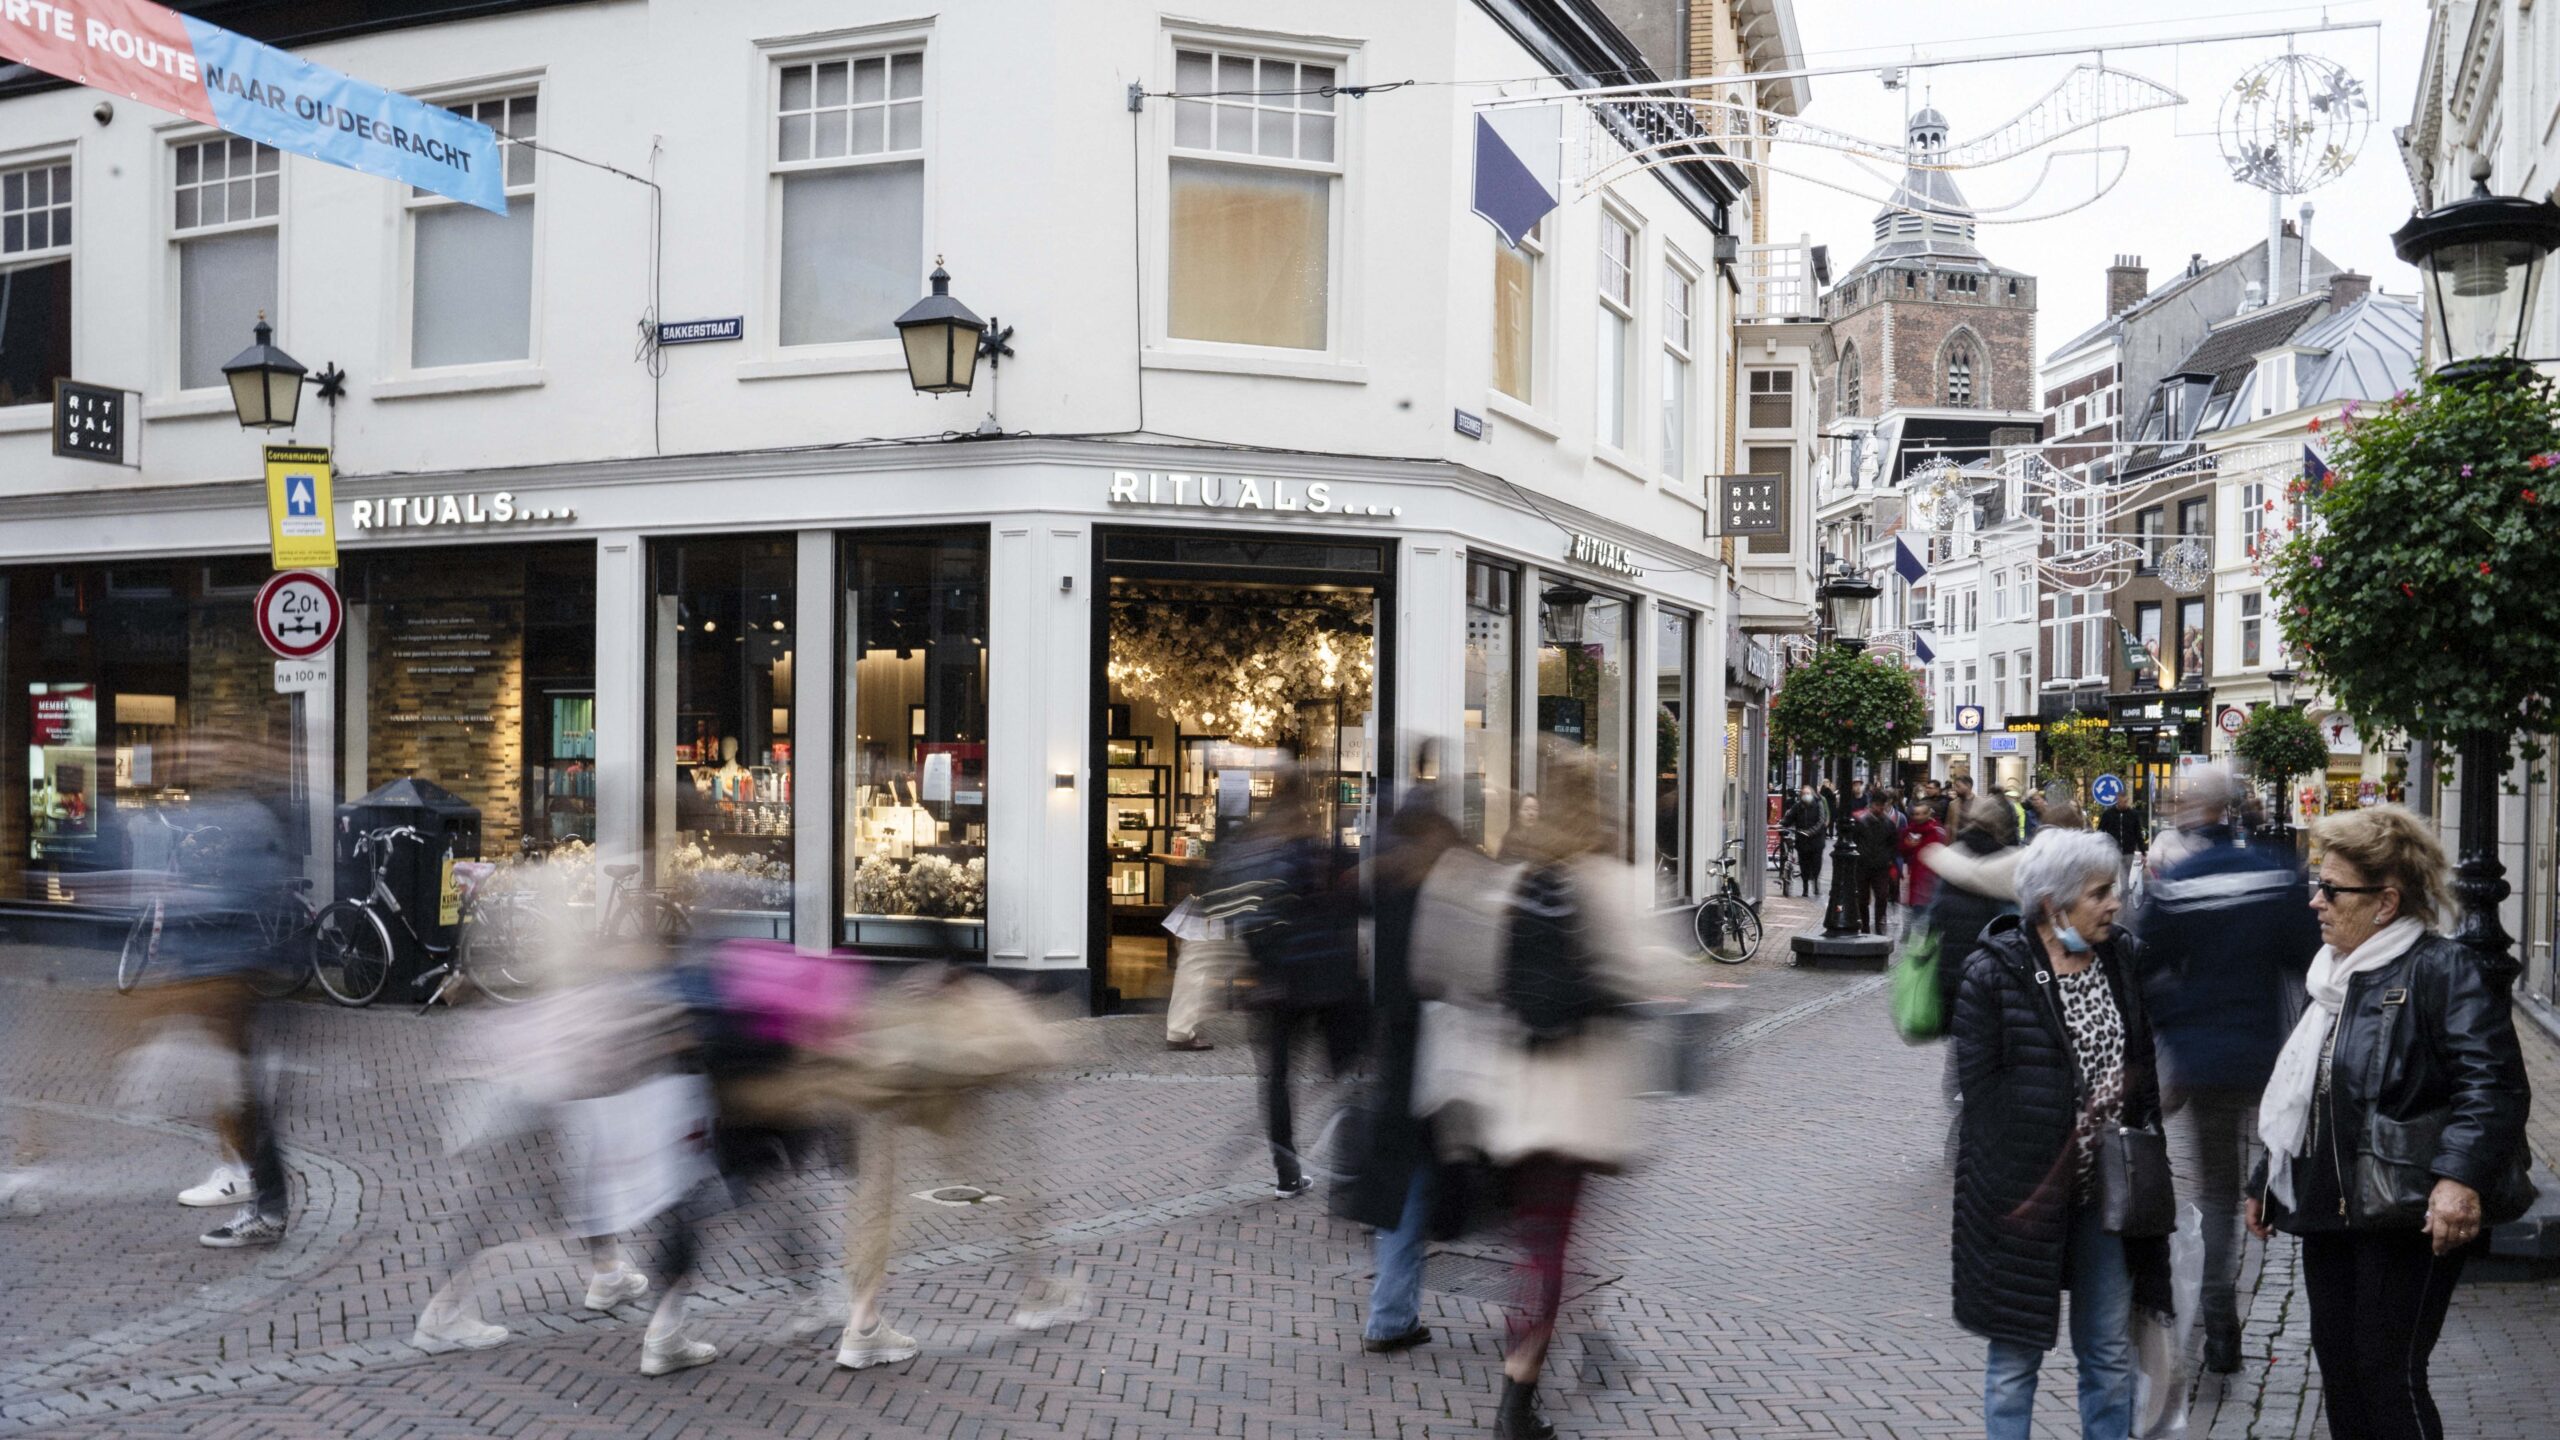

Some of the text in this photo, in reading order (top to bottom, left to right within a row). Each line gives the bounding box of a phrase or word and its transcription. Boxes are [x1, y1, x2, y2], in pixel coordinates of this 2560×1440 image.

[0, 0, 472, 173] RTE ROUTE NAAR OUDEGRACHT
[662, 321, 736, 340] BAKKERSTRAAT
[278, 671, 327, 683] na 100 m
[2008, 722, 2041, 732] sacha
[2073, 717, 2110, 728] sacha
